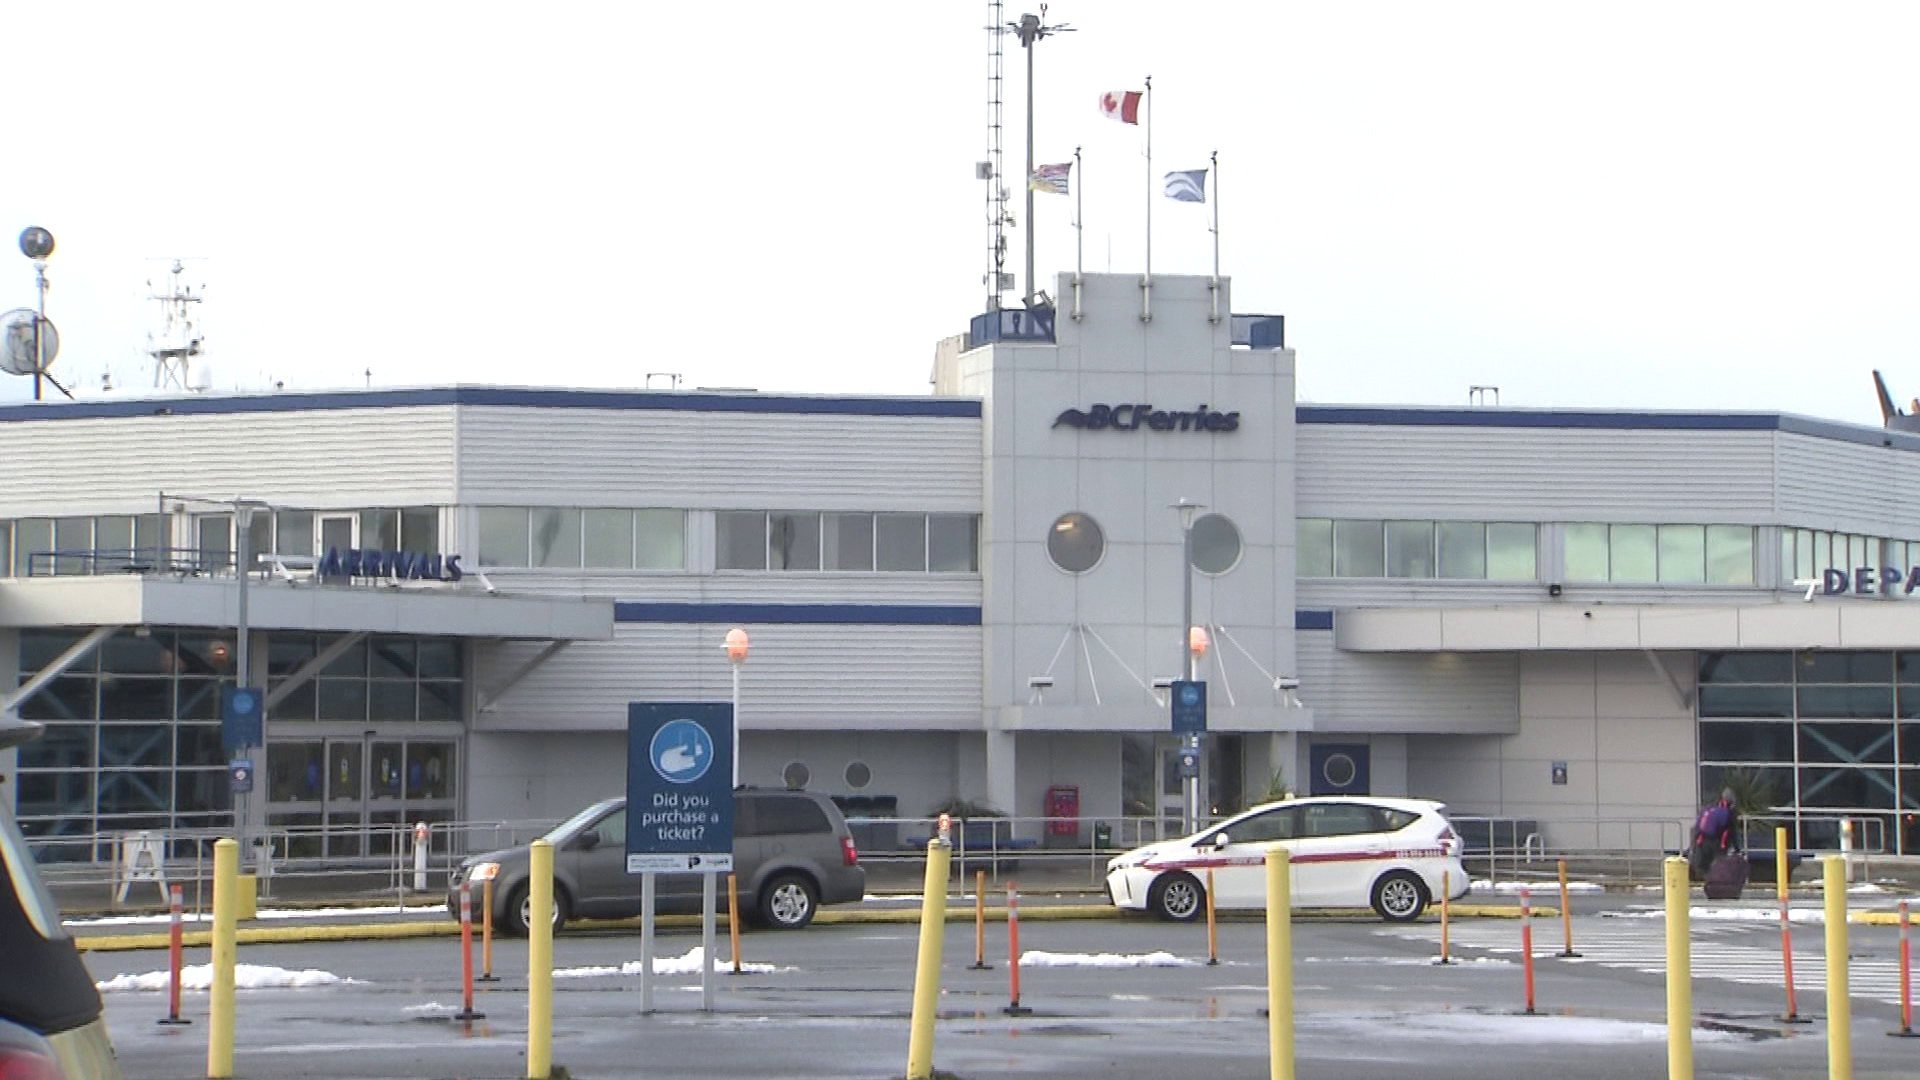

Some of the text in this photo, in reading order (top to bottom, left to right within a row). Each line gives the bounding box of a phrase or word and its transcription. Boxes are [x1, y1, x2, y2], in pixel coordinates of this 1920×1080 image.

[318, 545, 462, 582] ARRIVALS
[653, 792, 709, 810] Did you
[642, 809, 719, 827] purchase a
[658, 825, 704, 840] ticket?
